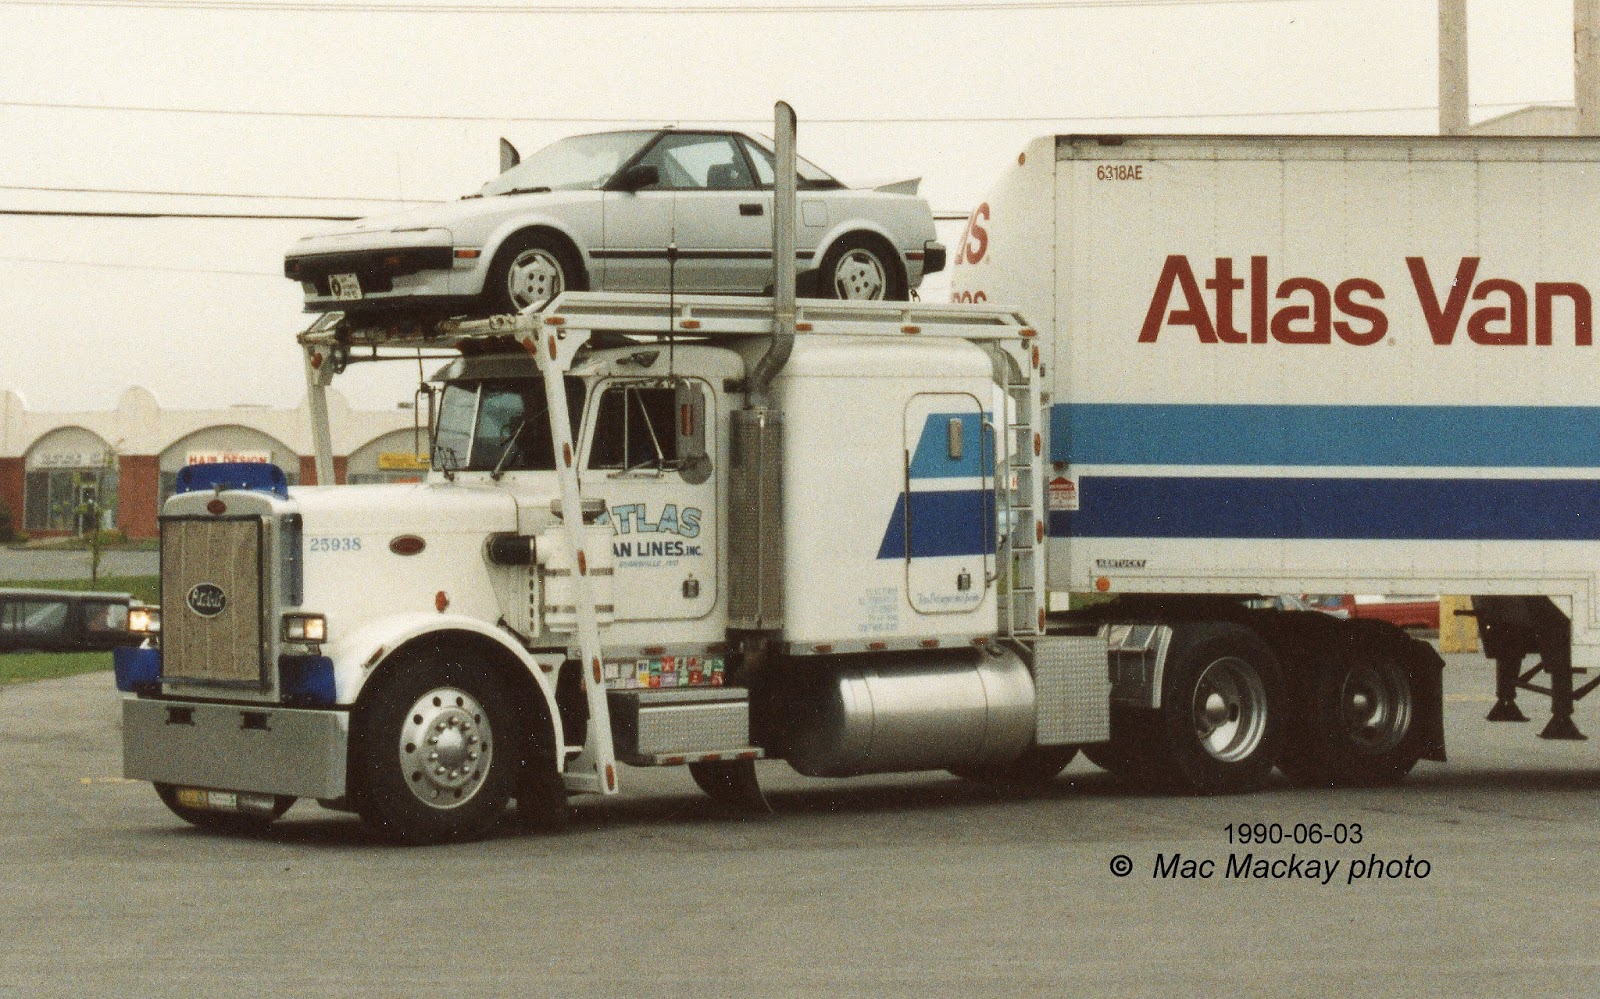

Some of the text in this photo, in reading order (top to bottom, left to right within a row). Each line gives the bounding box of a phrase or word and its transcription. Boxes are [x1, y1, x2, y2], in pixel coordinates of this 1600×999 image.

[1096, 164, 1143, 180] 6318AE
[1137, 254, 1593, 346] Atlas Van
[310, 537, 362, 551] 25938
